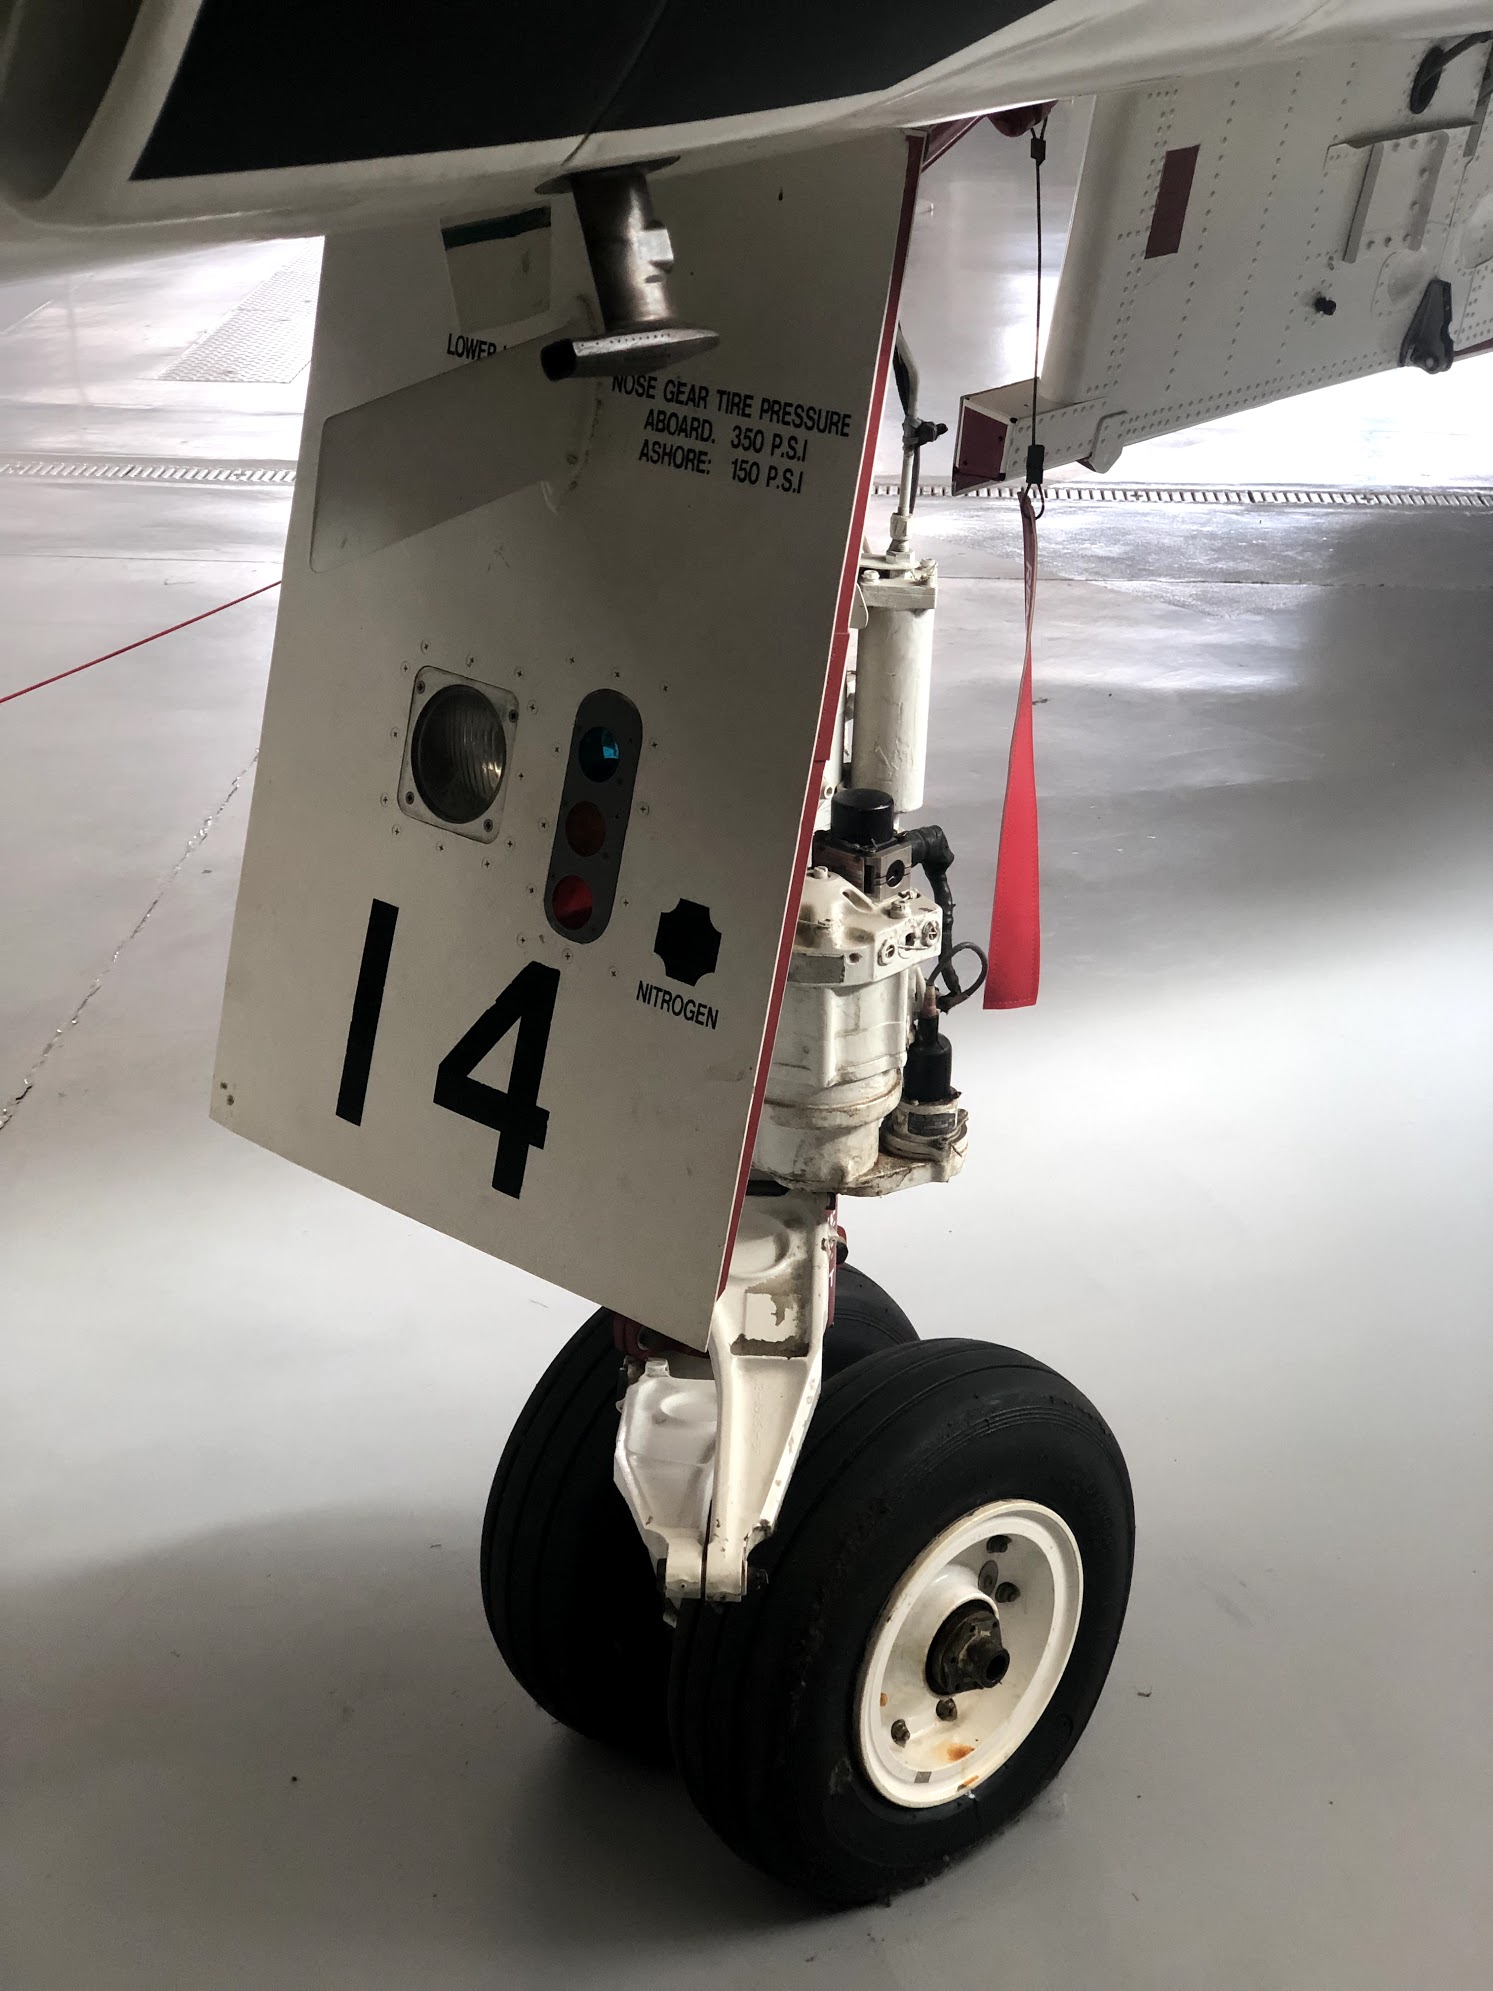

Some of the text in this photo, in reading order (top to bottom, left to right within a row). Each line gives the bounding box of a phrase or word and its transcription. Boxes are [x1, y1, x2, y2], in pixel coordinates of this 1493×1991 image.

[611, 374, 852, 437] NOSE GEAR TIRE PRESSURE
[638, 438, 804, 494] ASHORE: 150 P.S.I
[730, 425, 764, 453] 350
[770, 432, 808, 462] P.S.I
[635, 980, 720, 1030] NITROGEN
[335, 898, 561, 1199] 14
